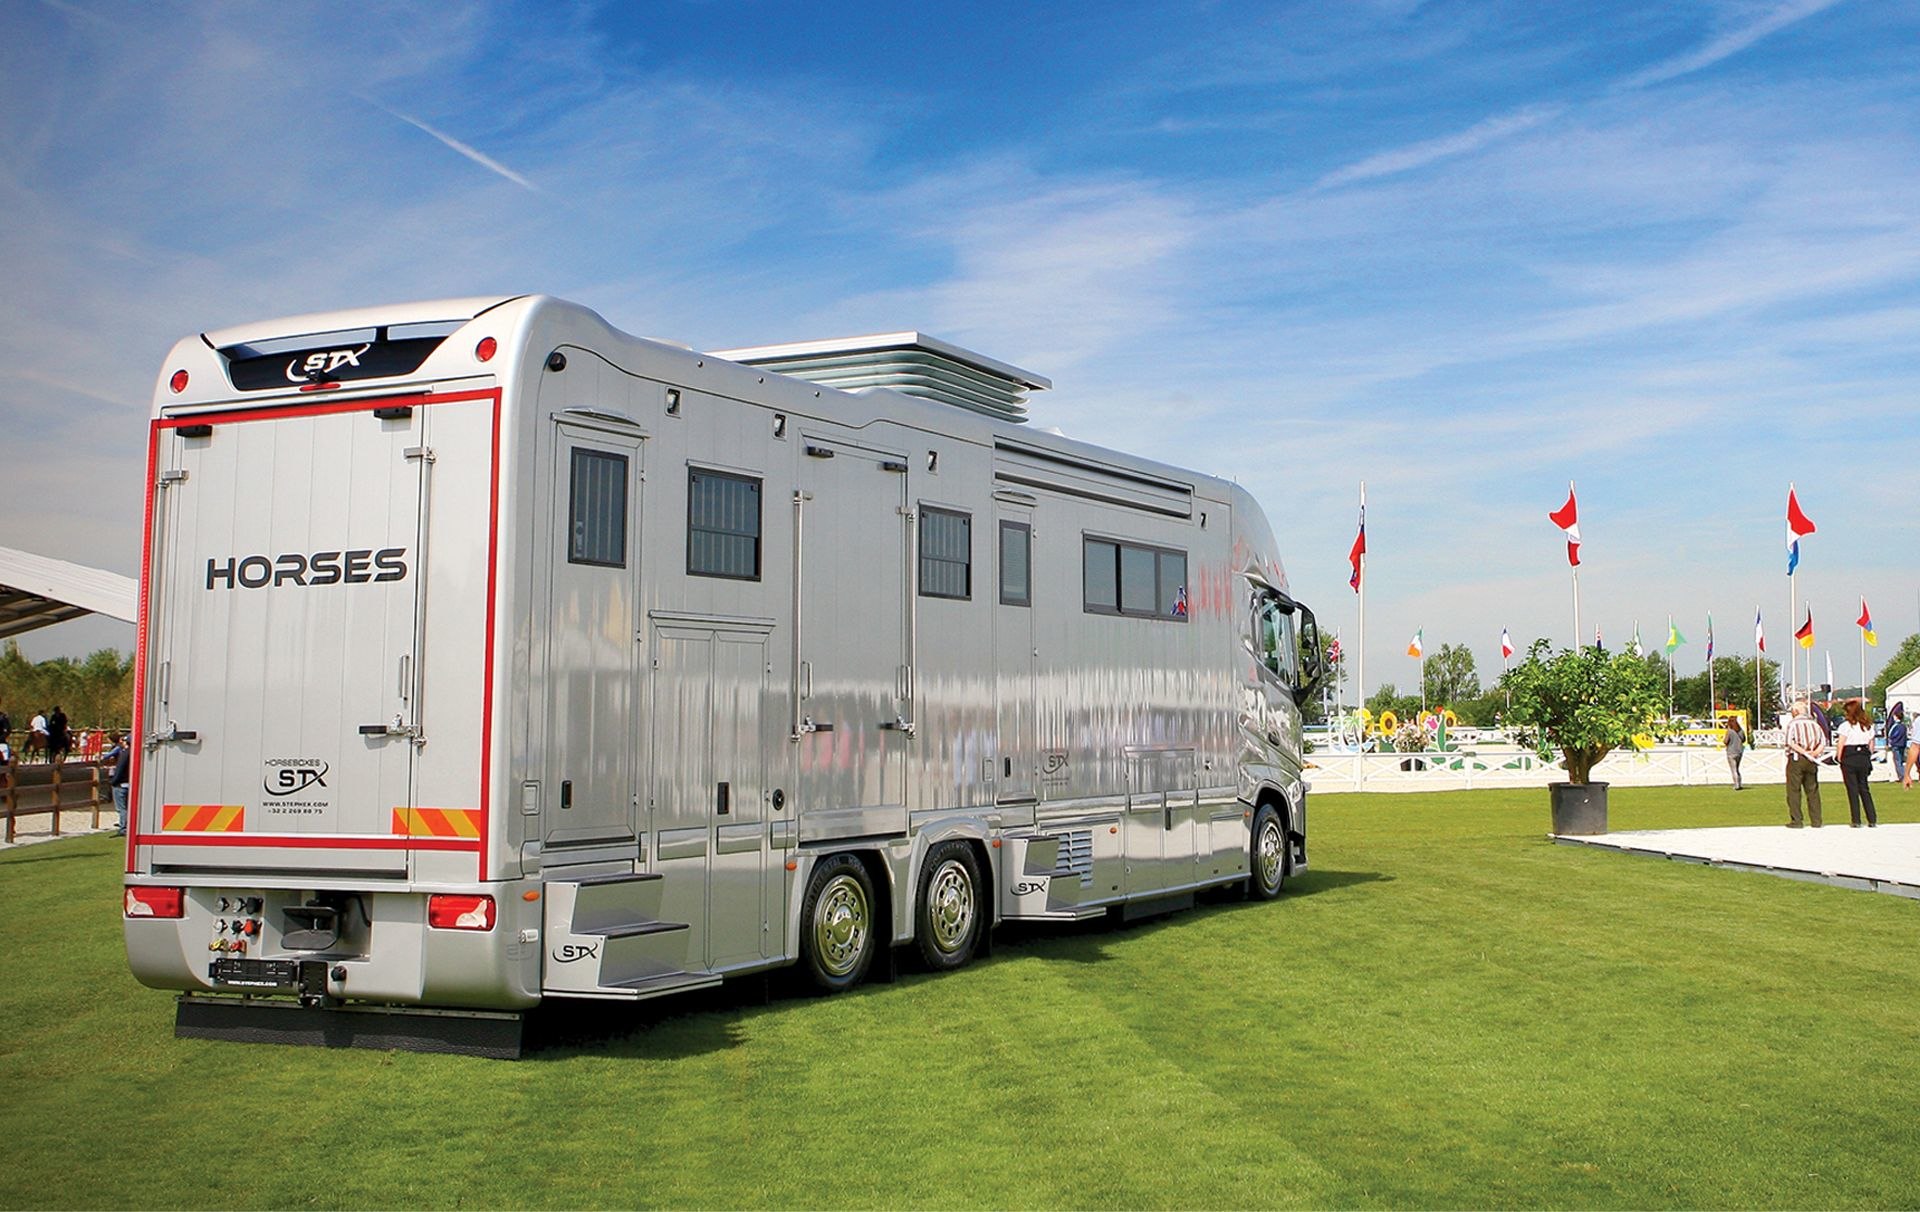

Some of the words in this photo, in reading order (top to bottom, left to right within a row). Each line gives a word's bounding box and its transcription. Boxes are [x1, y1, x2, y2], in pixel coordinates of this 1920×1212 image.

[303, 343, 370, 374] STX
[207, 548, 408, 590] HORSES
[265, 759, 320, 767] HORSEBOXES
[279, 761, 329, 788] STX
[1018, 880, 1046, 893] STX
[563, 942, 598, 959] STX
